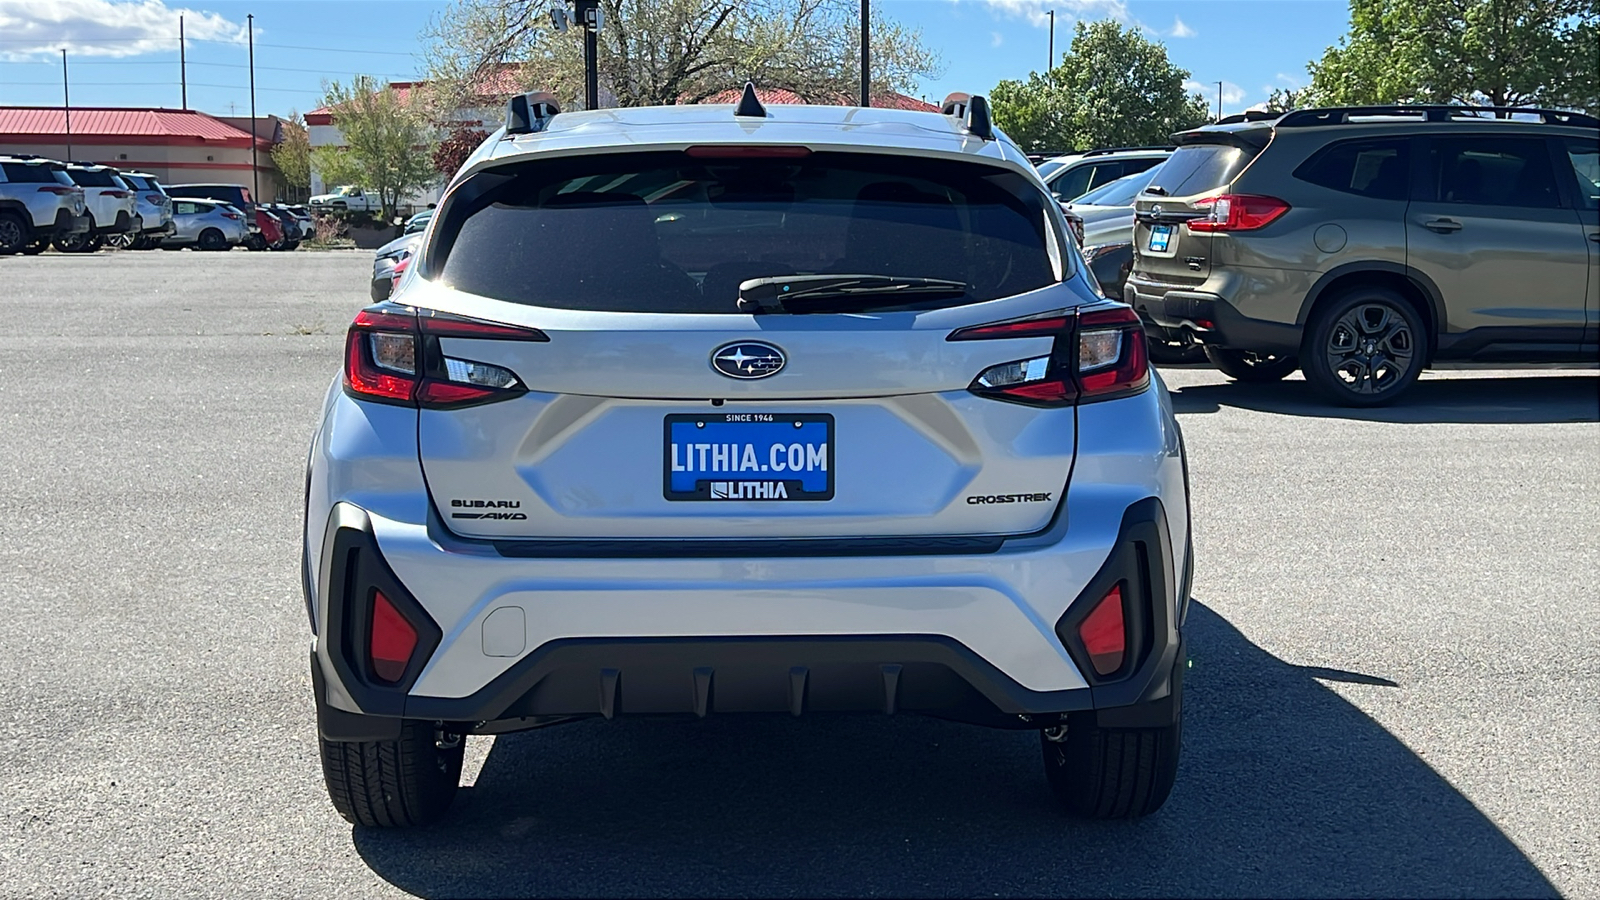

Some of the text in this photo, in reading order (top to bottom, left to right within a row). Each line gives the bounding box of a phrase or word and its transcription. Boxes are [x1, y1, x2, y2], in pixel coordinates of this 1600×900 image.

[726, 414, 774, 422] SINCE 1946
[671, 443, 828, 472] LITHIA.COM
[728, 481, 788, 499] LITHIA
[451, 499, 520, 508] SUBARU
[966, 492, 1052, 505] CROSSTREK
[480, 512, 528, 520] AWD
